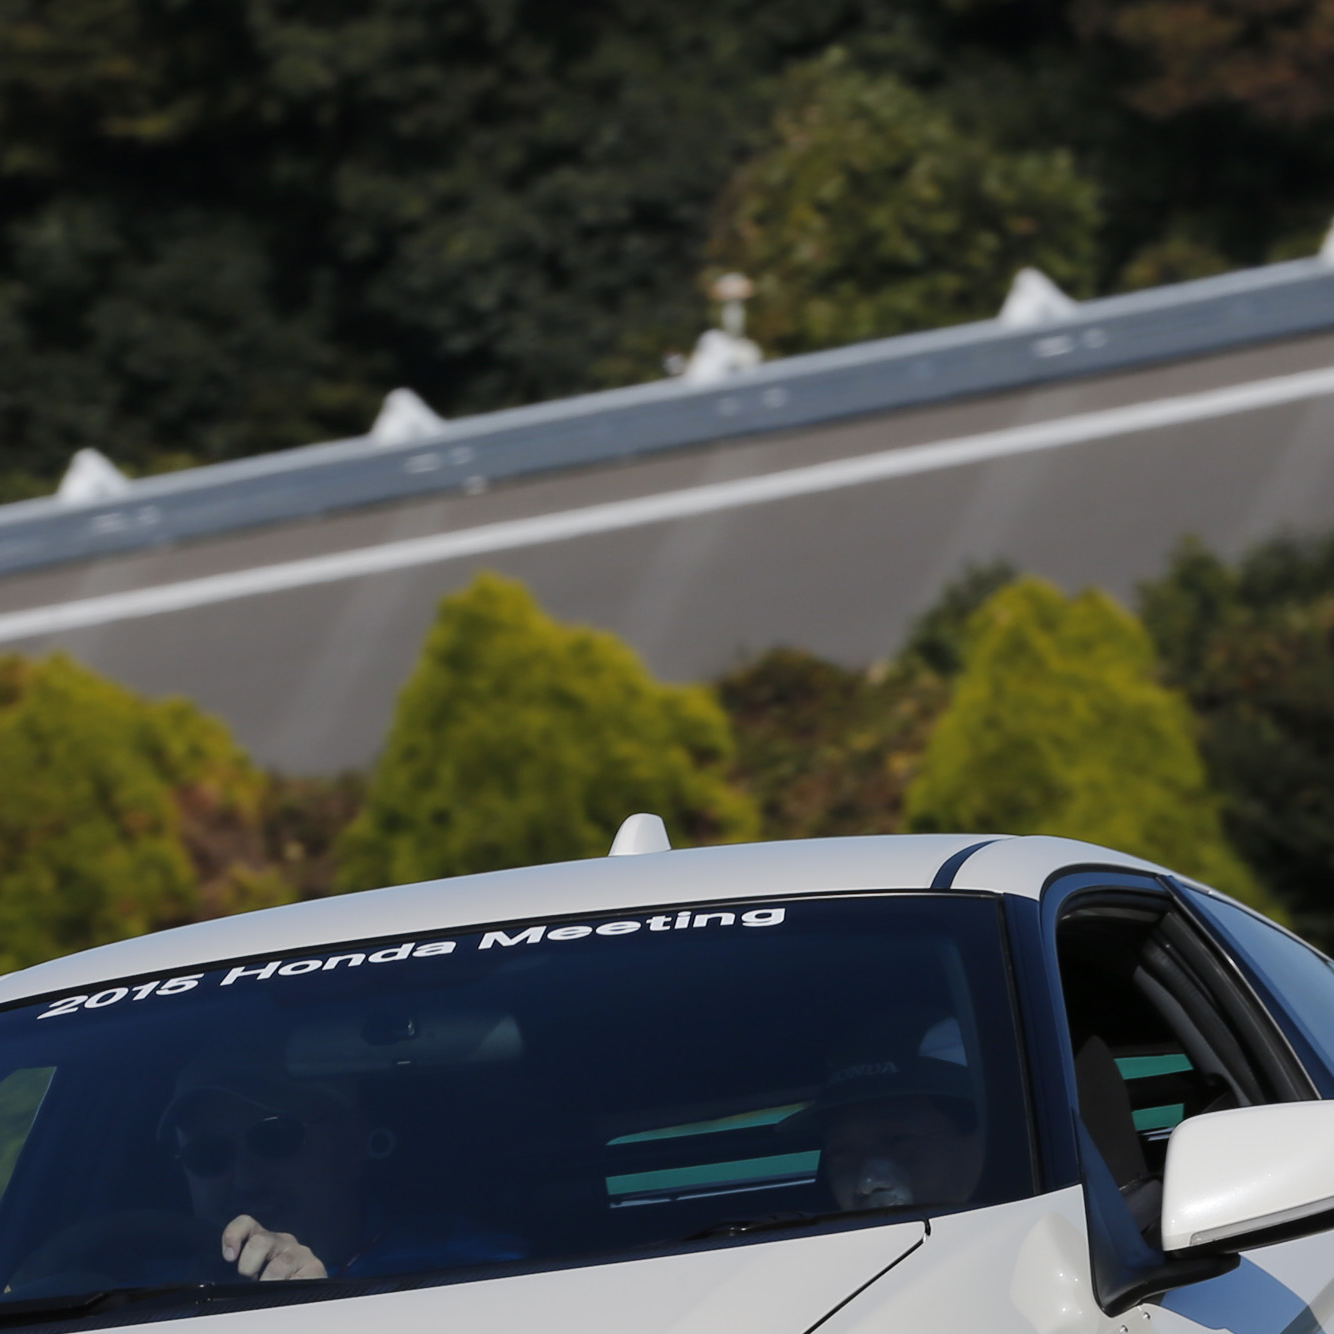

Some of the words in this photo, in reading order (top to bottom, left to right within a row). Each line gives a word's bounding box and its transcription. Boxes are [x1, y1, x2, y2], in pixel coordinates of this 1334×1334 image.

[36, 973, 205, 1020] 2015
[219, 939, 456, 986] Honda
[477, 907, 787, 950] Meeting
